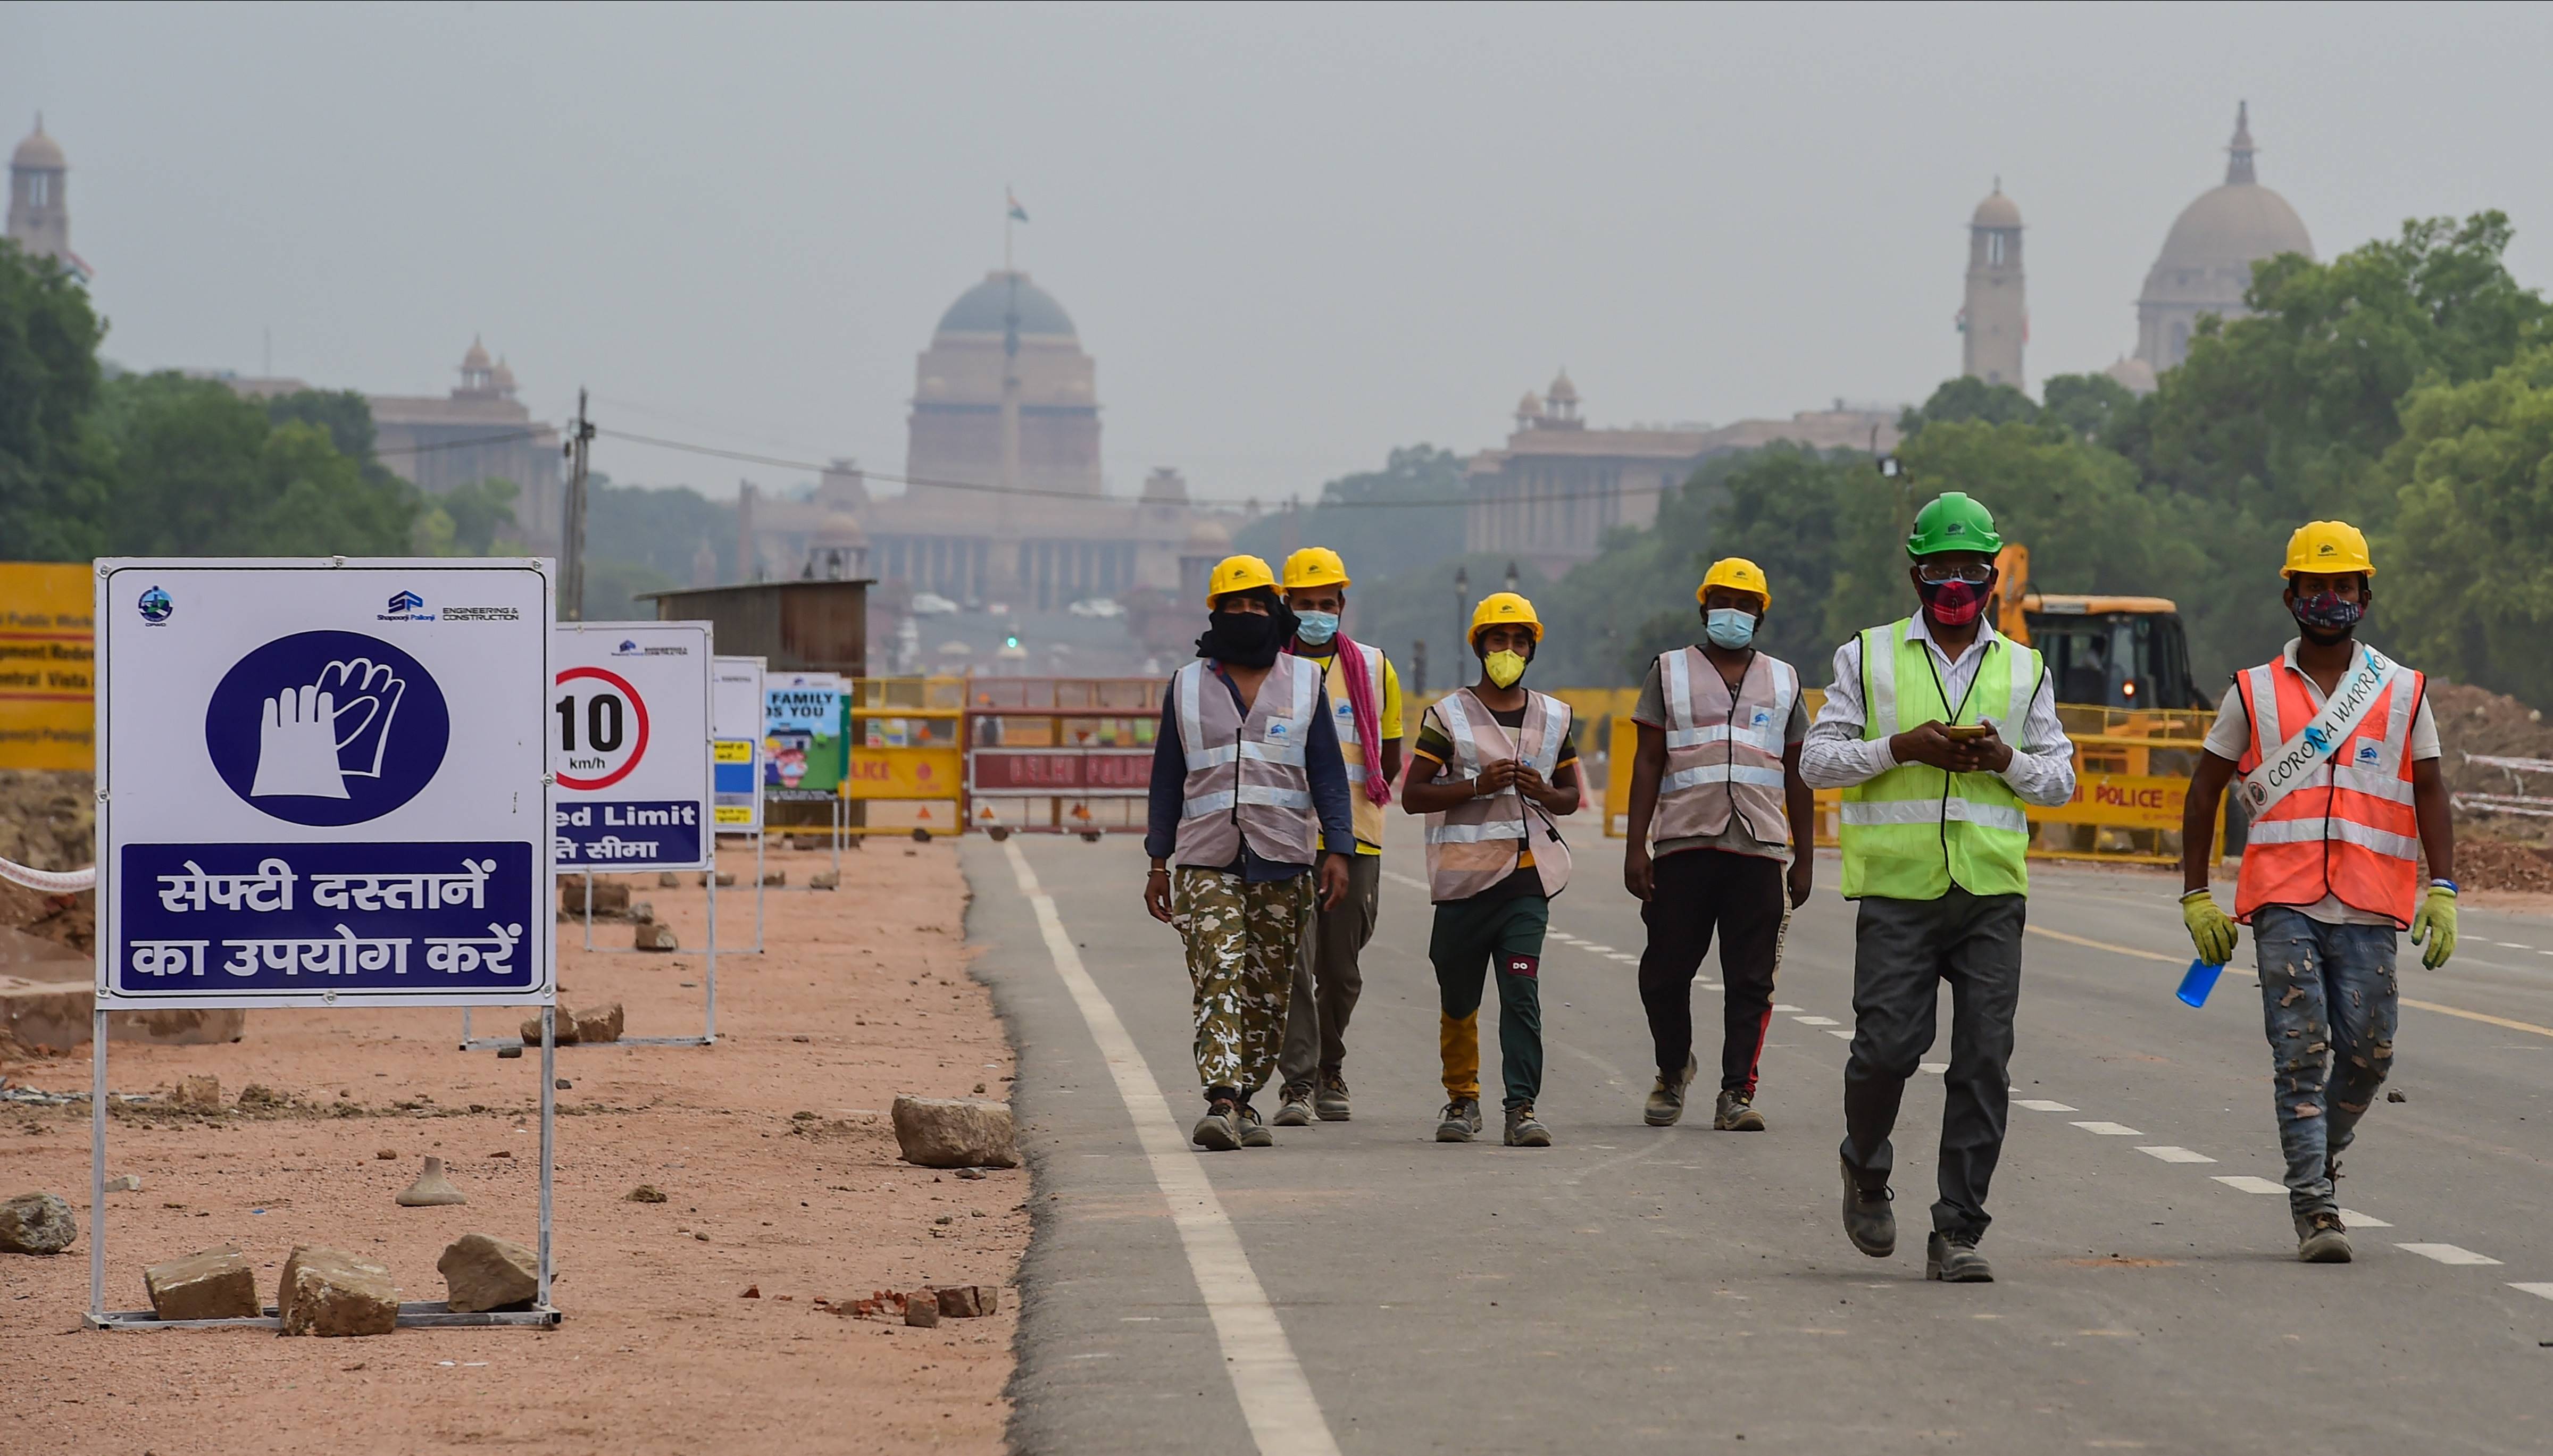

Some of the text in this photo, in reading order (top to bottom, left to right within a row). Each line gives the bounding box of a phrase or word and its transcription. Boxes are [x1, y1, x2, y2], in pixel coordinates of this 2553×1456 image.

[772, 693, 832, 704] FAMILY
[556, 694, 623, 752] 10
[790, 706, 824, 717] YOU
[570, 757, 605, 769] km/h
[2268, 720, 2339, 788] CORONA
[851, 762, 889, 781] LICE
[1010, 755, 1154, 785] DELHI POLIC
[2096, 784, 2163, 808] POLICE
[605, 806, 695, 825] Limit
[585, 835, 660, 858] सीमा
[157, 858, 497, 912] सेफ्टी दस्तानें
[130, 922, 523, 976] का उपयोग करें
